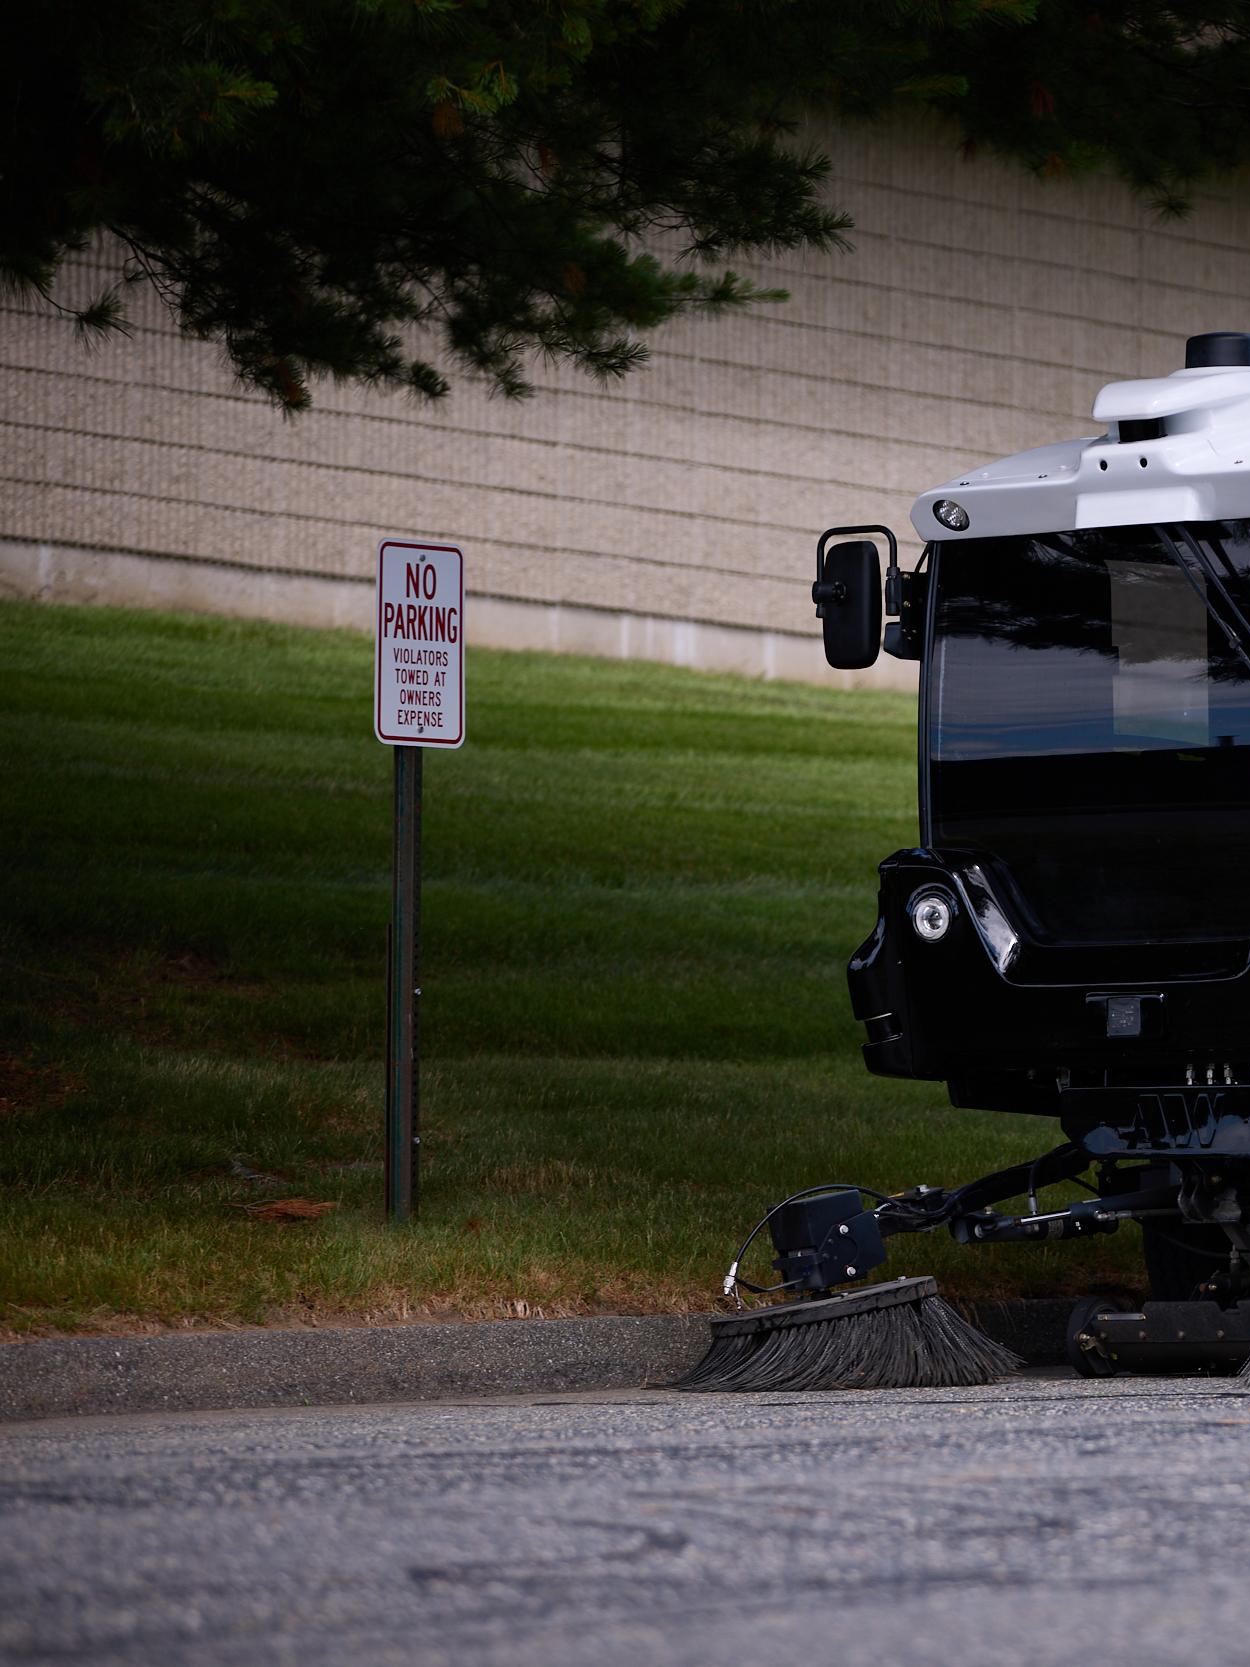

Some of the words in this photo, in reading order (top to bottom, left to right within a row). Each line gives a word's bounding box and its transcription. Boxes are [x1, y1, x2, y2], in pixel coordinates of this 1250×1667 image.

[406, 562, 437, 600] NO
[384, 602, 458, 644] PARKING
[393, 647, 449, 667] VIOLATORS
[395, 668, 429, 684] TOWED
[434, 671, 446, 687] AT
[400, 688, 442, 707] OWNERS
[397, 709, 443, 728] EXPENSE
